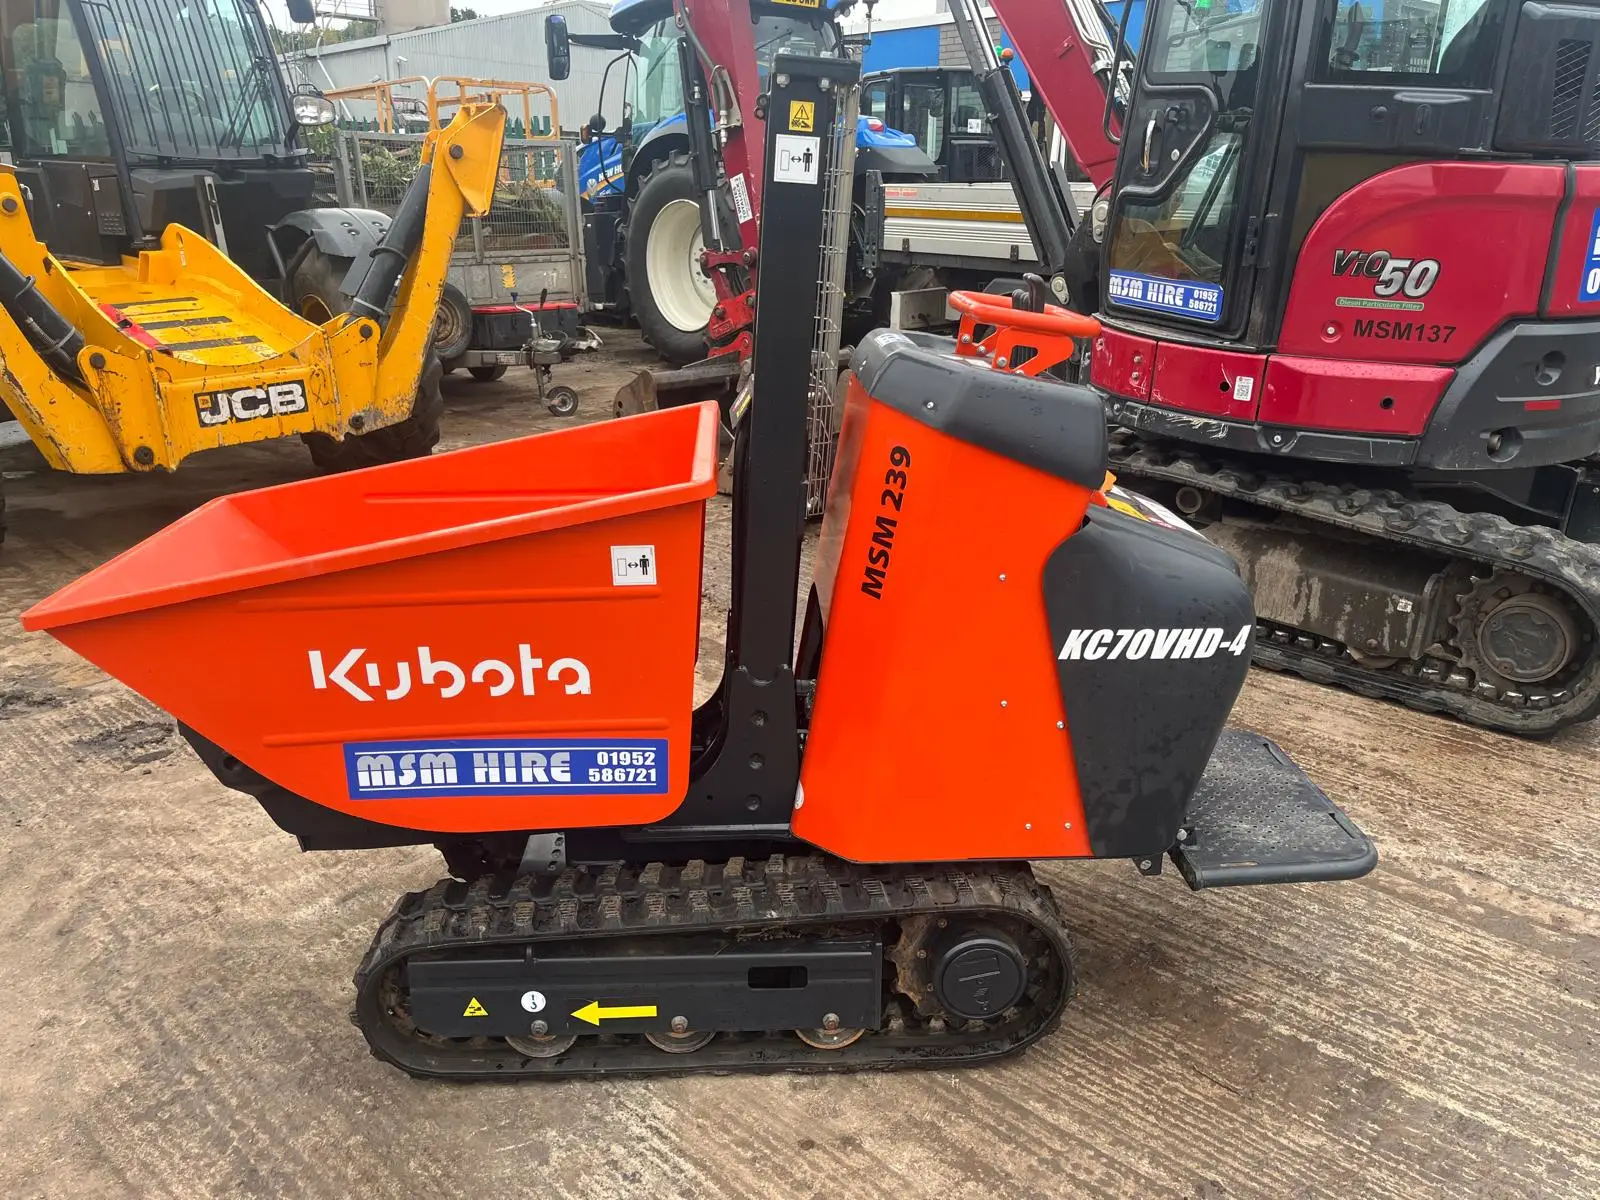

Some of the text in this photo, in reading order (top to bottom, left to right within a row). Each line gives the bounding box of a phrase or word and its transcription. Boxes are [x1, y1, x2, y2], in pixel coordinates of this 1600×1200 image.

[1109, 277, 1219, 306] MSM HIRE 01952
[1188, 299, 1217, 312] 586721
[1362, 300, 1400, 309] Particulate
[1353, 319, 1457, 343] MSM137
[200, 383, 306, 424] JCB
[861, 446, 911, 600] MSM 239
[1058, 624, 1251, 660] KC70VHD-4
[308, 643, 592, 702] Kubota
[356, 751, 656, 787] MSM HIRE 01952
[588, 767, 657, 782] 586721
